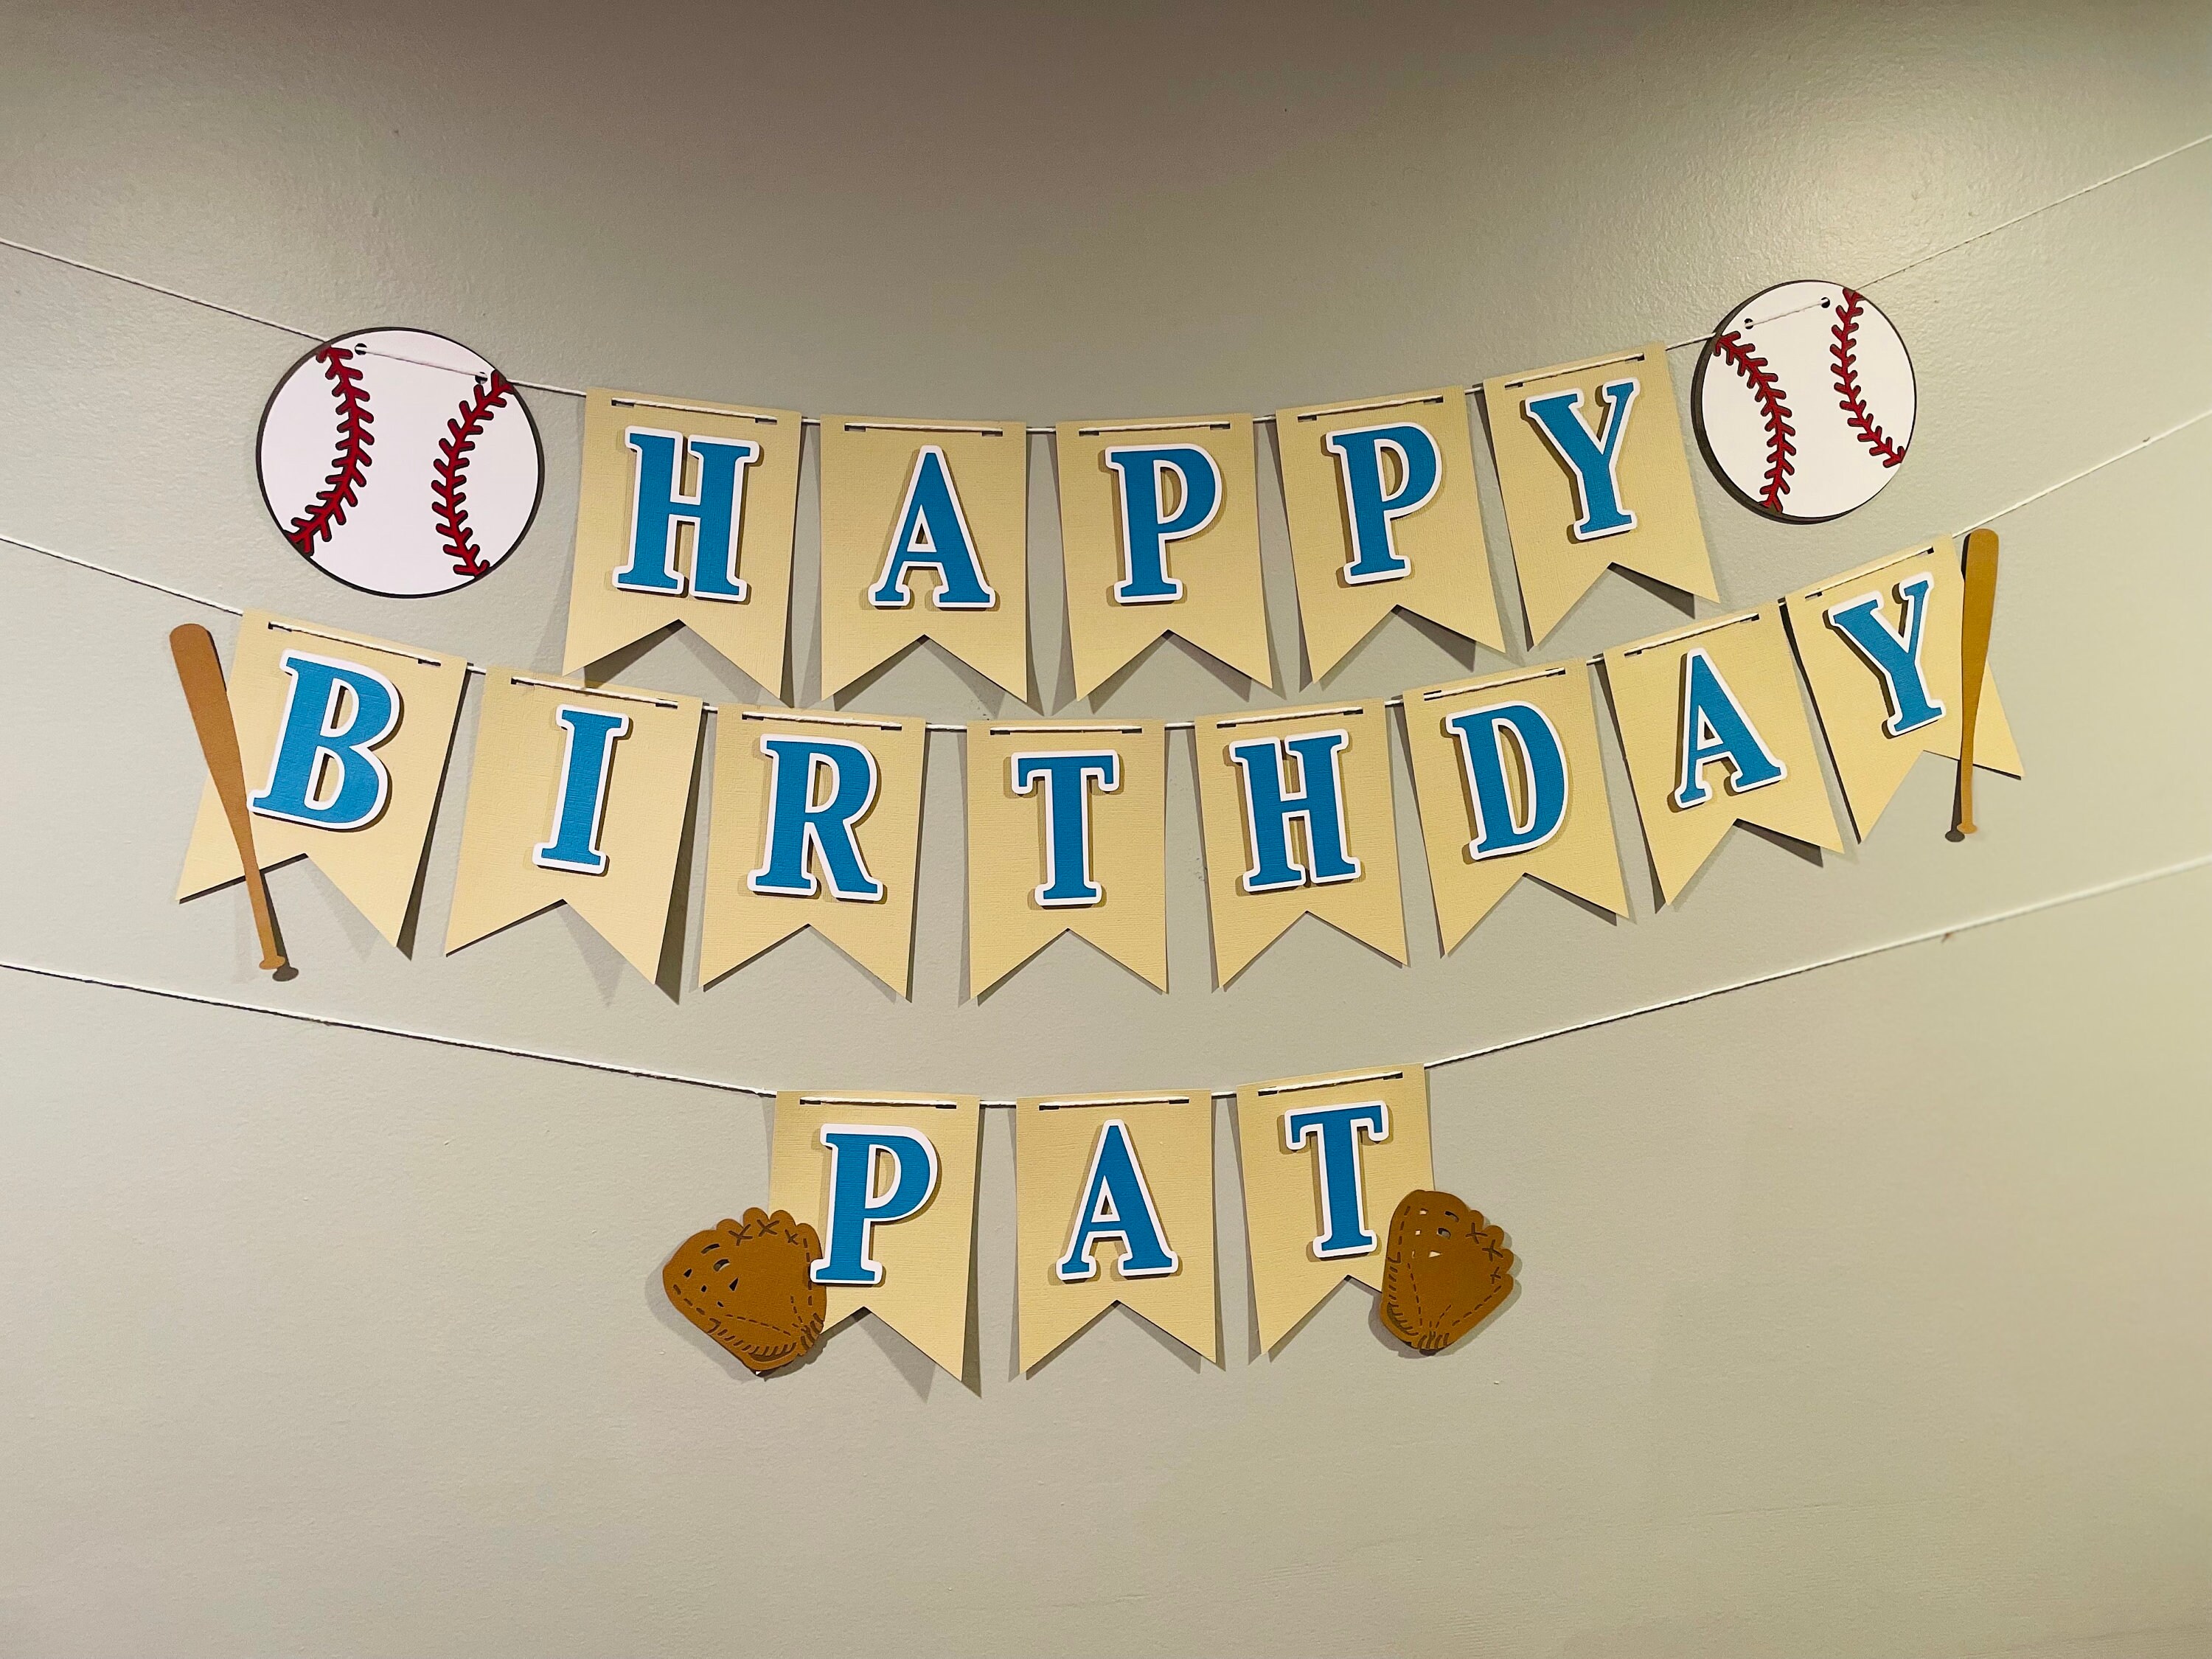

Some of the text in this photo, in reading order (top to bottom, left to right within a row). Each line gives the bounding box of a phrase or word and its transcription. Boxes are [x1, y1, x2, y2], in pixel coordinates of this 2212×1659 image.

[612, 377, 1639, 610] HAPPY
[247, 572, 1947, 907] BIRTHDAY
[810, 1100, 1389, 1286] PAT
